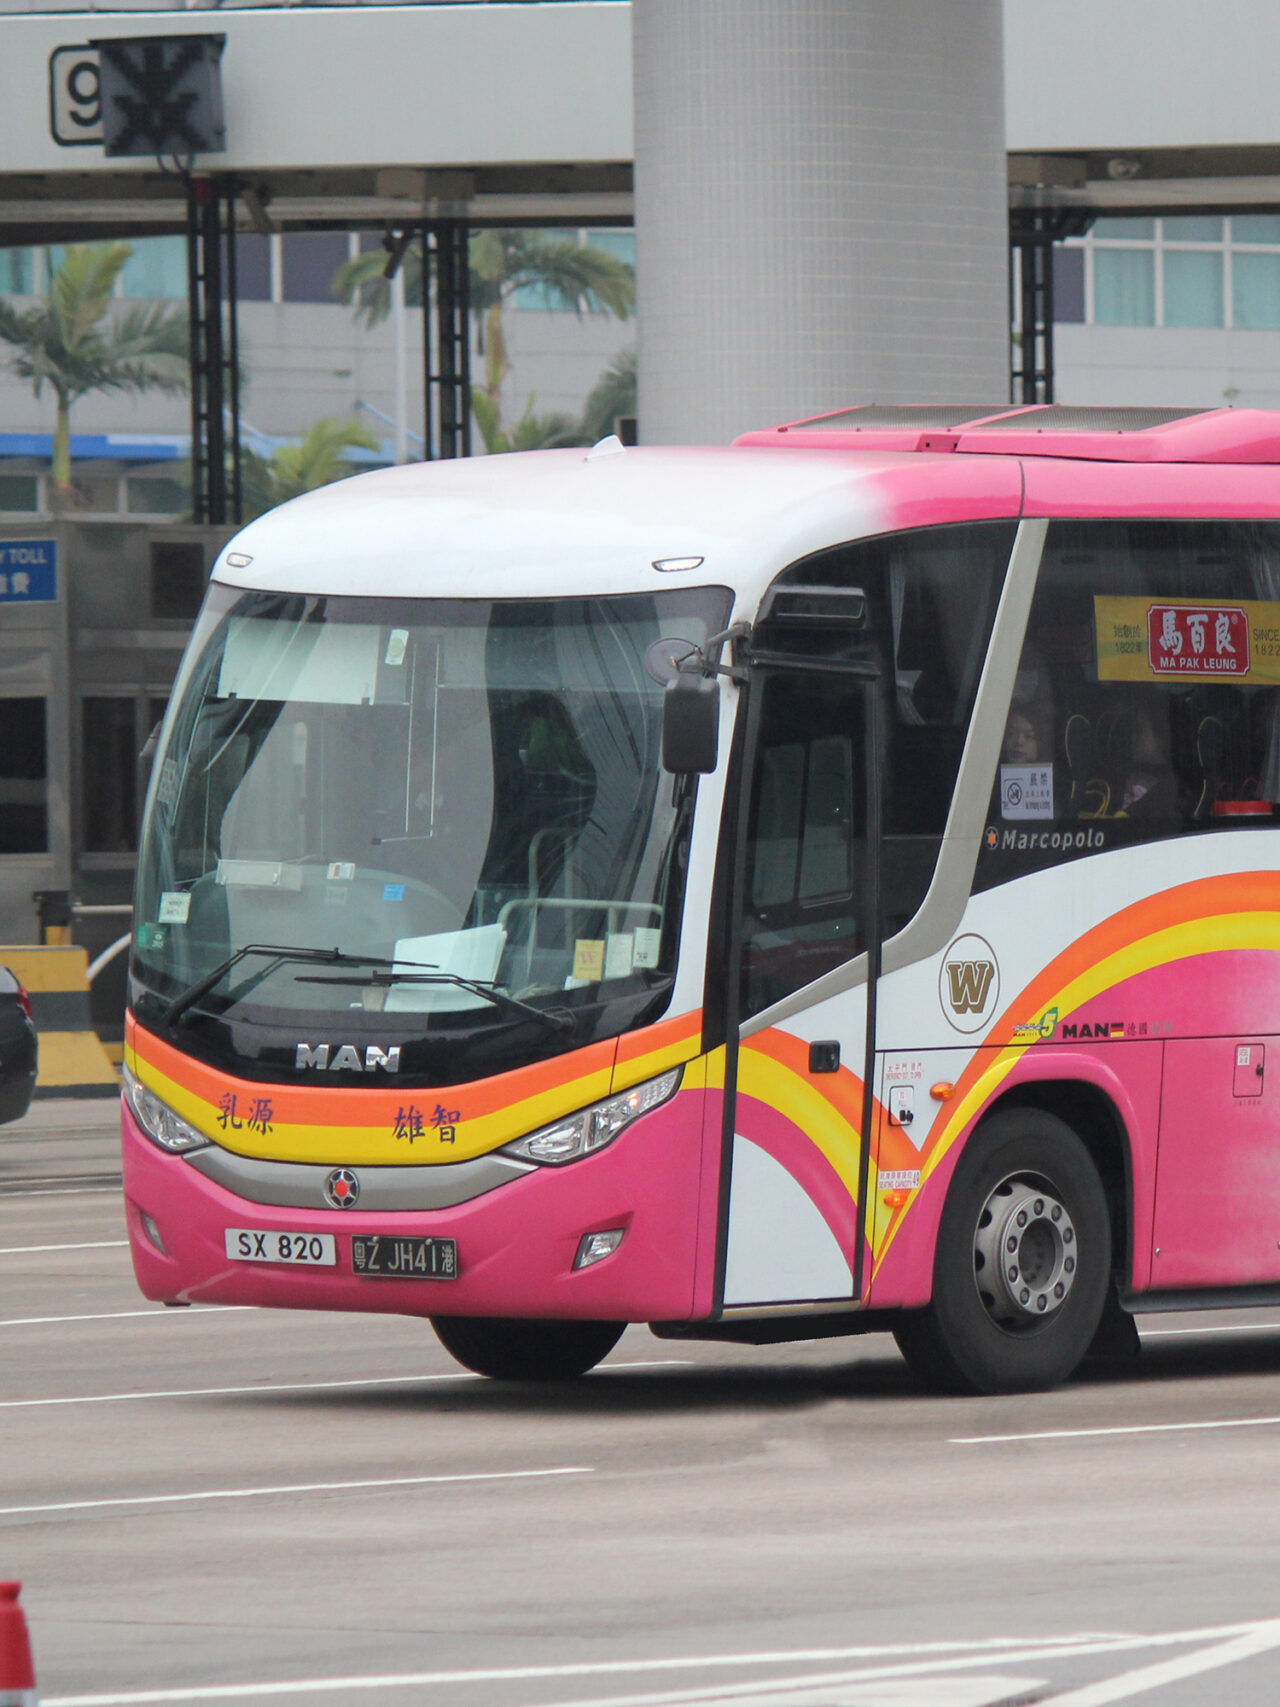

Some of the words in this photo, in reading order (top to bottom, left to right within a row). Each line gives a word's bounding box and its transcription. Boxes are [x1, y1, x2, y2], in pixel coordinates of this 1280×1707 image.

[67, 61, 102, 127] 9
[8, 548, 47, 564] TOLL
[1159, 610, 1237, 656] 馬百良
[1252, 628, 1280, 642] SINCE
[1160, 657, 1176, 668] MA
[1179, 657, 1200, 669] PAK
[1203, 658, 1237, 670] LEUNG
[1254, 644, 1280, 657] 1822
[1002, 828, 1105, 851] Marcopolo
[946, 960, 995, 1014] W
[1062, 1022, 1110, 1039] MAN
[295, 1043, 401, 1073] MAN
[217, 1092, 274, 1136] 乳源
[392, 1104, 461, 1144] 雄智
[238, 1232, 267, 1259] SX
[278, 1235, 323, 1261] 820
